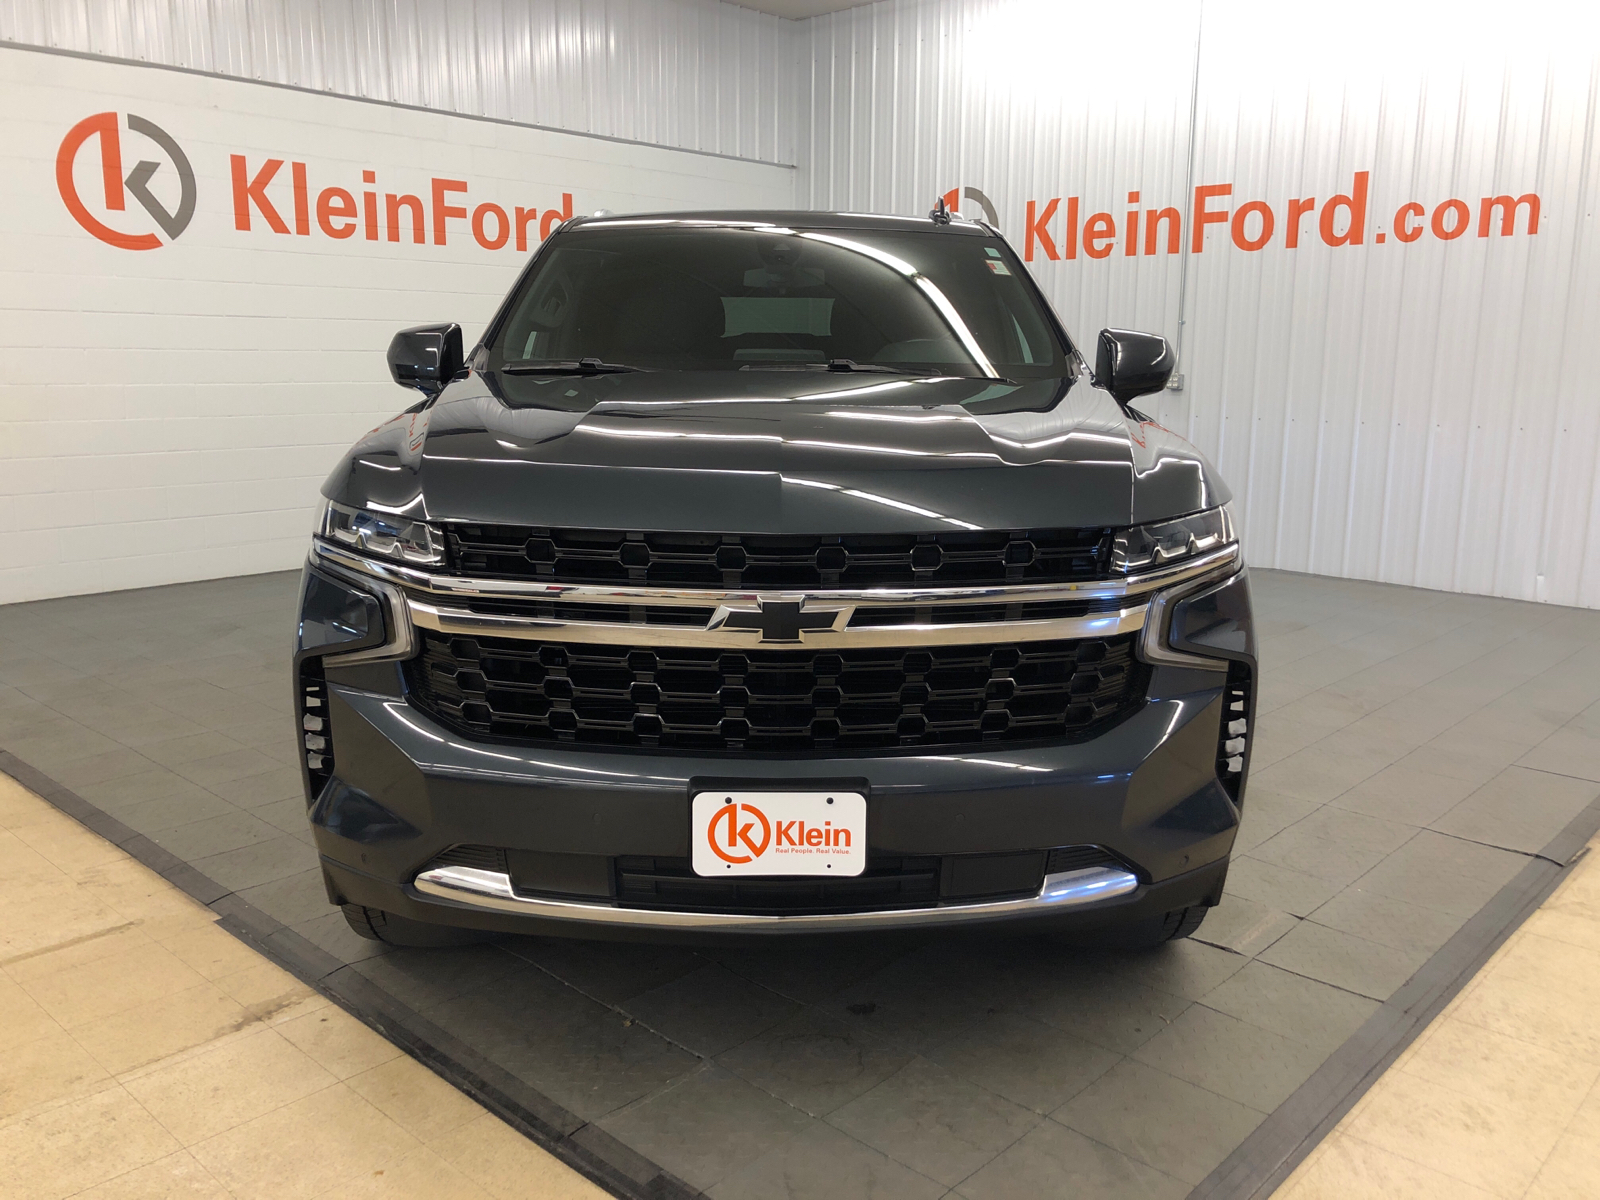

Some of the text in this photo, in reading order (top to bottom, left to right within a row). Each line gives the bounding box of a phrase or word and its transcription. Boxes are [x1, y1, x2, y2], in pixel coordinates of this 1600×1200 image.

[230, 154, 573, 252] KleinFord
[1024, 171, 1541, 263] KleinFord.com
[775, 820, 852, 847] Klein
[790, 847, 815, 855] People.
